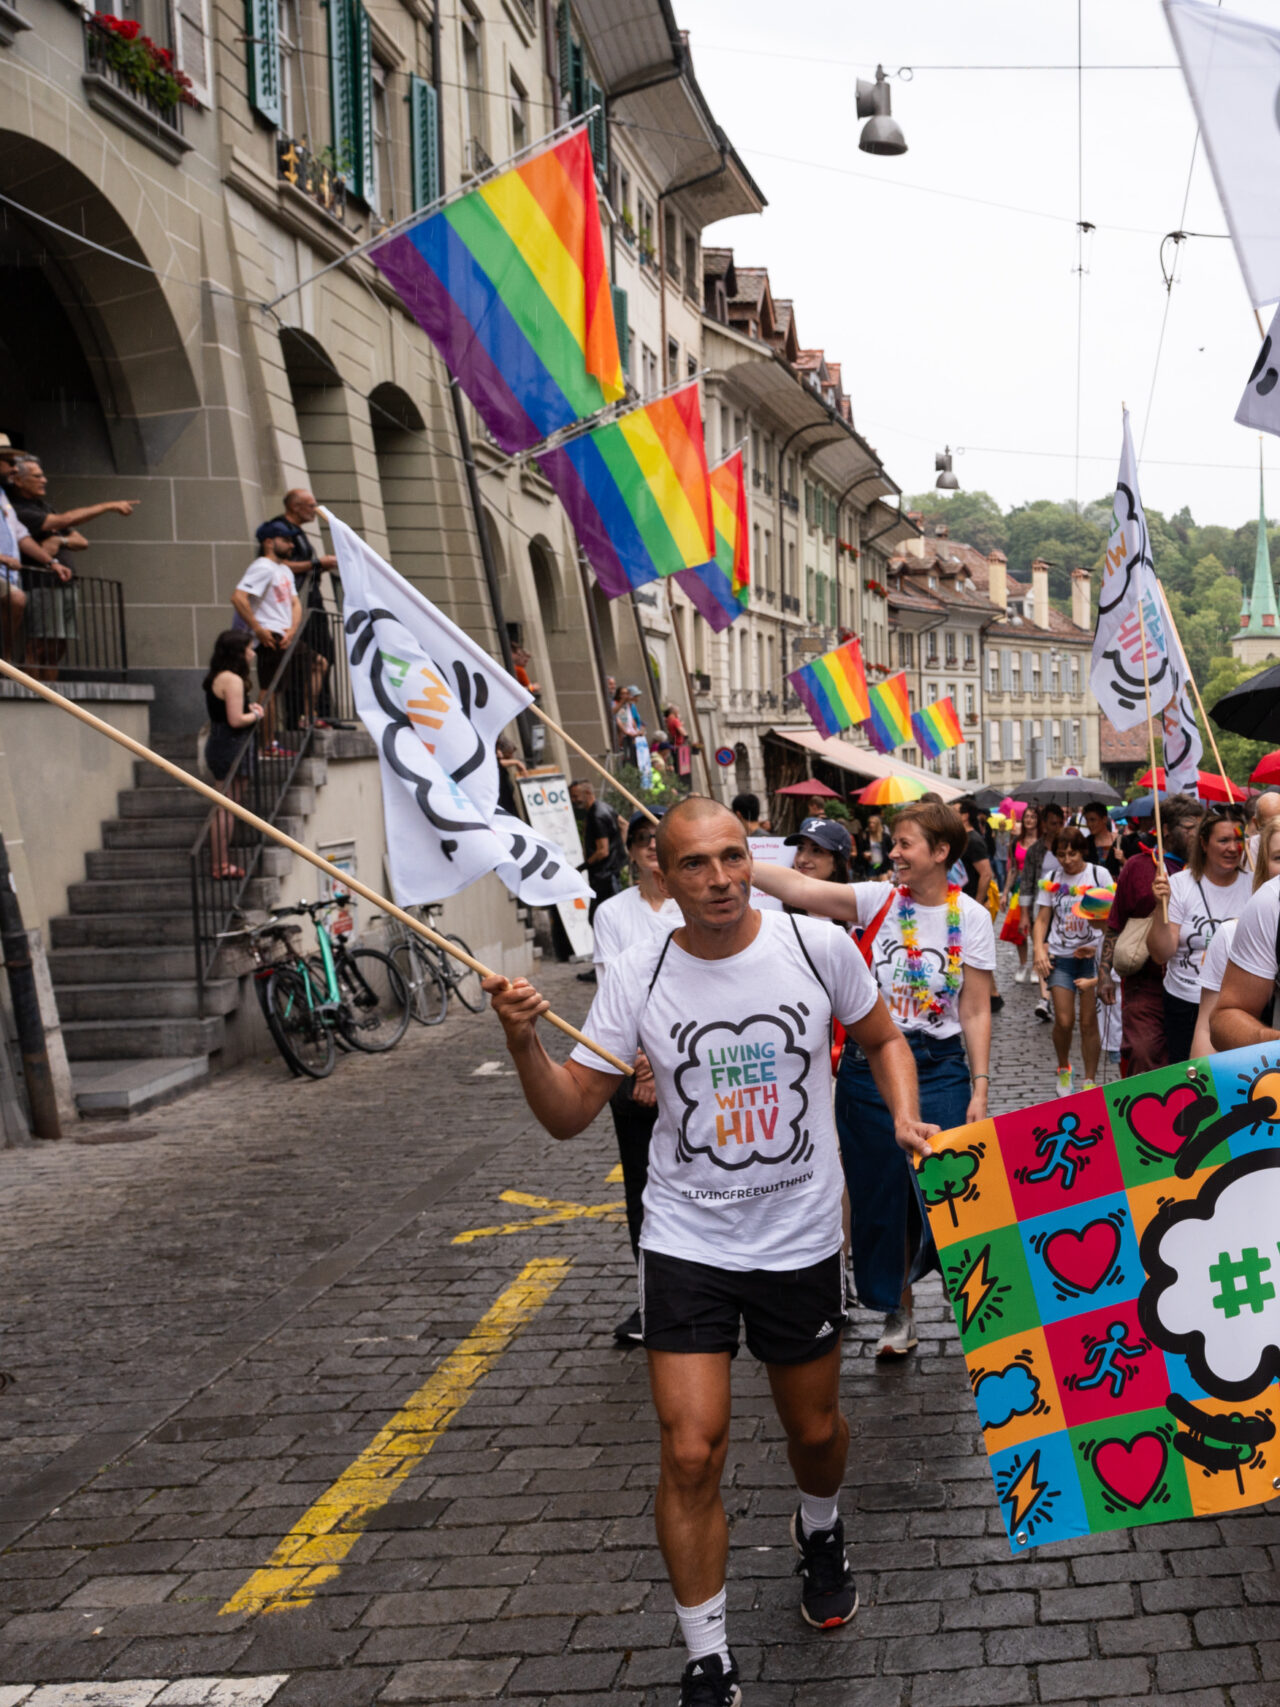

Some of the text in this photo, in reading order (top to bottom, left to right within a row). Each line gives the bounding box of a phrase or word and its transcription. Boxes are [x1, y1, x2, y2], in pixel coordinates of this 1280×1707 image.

[1117, 611, 1158, 664] HIV
[708, 1042, 776, 1066] LIVING
[711, 1061, 777, 1089] FREE
[714, 1083, 779, 1110] WITH
[715, 1106, 779, 1147] HIV
